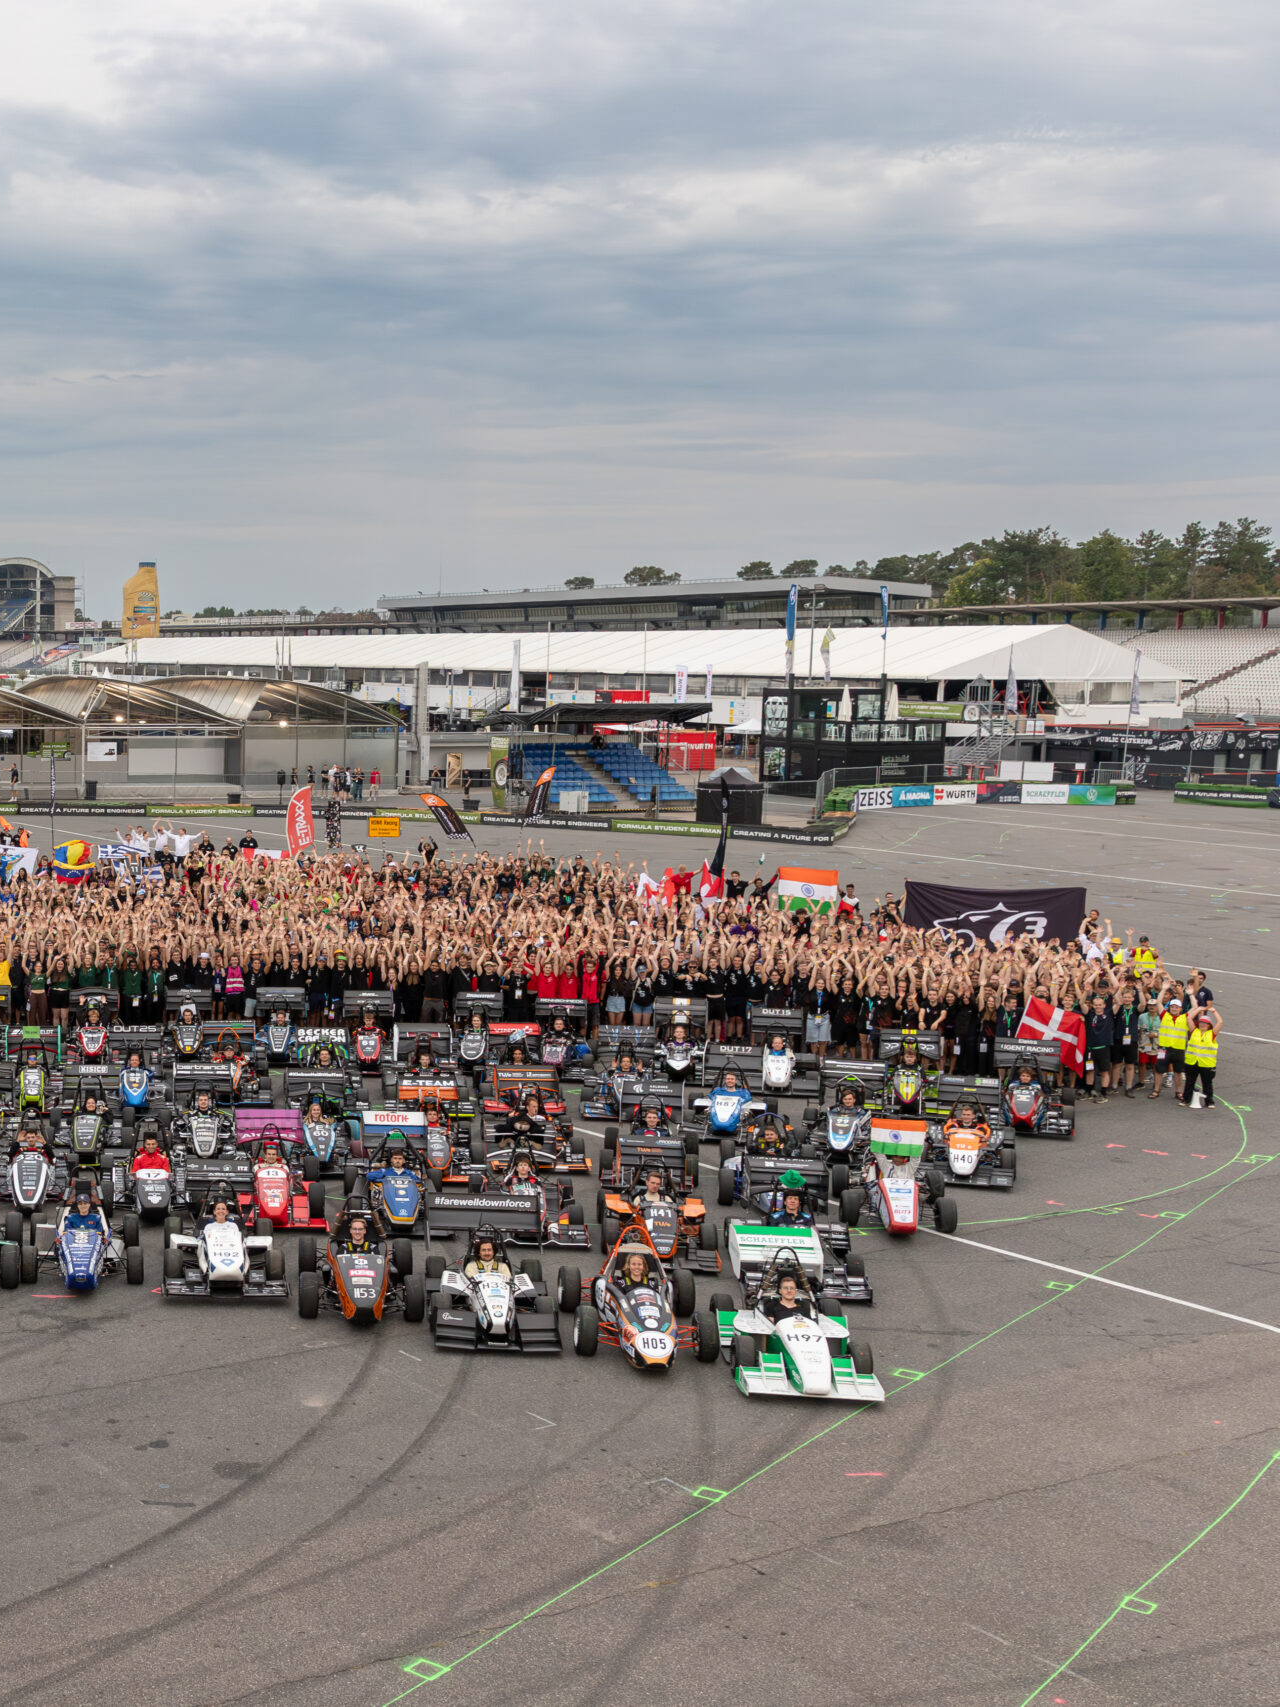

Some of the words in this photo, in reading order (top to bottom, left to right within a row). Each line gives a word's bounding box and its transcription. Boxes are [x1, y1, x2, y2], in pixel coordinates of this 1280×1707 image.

[860, 790, 893, 807] ZEISS
[946, 790, 976, 800] WÜRTH
[291, 799, 310, 846] E-TRAXX
[733, 830, 771, 838] CREATING
[780, 833, 811, 841] FUTURE
[297, 1028, 346, 1036] BECKER
[1026, 1045, 1054, 1053] RACING
[402, 1079, 454, 1087] E-TEAM
[953, 1154, 973, 1164] H40
[434, 1196, 531, 1209] #farewelldownforce
[740, 1235, 806, 1245] SCHAEFFLER
[641, 1336, 668, 1350] H05
[786, 1333, 823, 1344] H97
